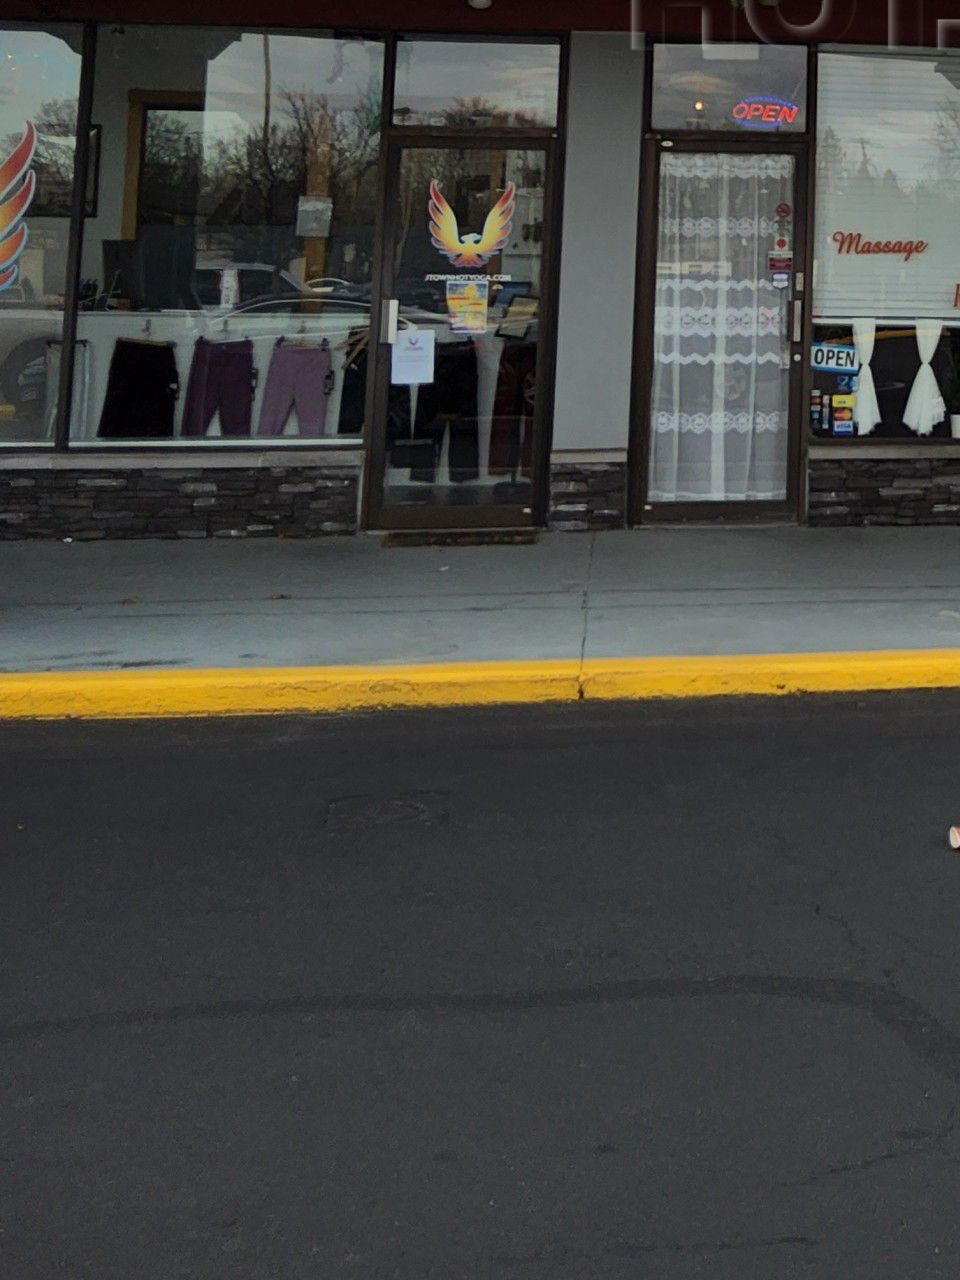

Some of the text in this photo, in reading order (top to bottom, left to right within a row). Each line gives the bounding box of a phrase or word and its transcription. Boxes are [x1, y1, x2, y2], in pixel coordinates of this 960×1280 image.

[732, 102, 798, 123] OPEN
[832, 231, 928, 262] Massage
[814, 348, 856, 368] OPEN
